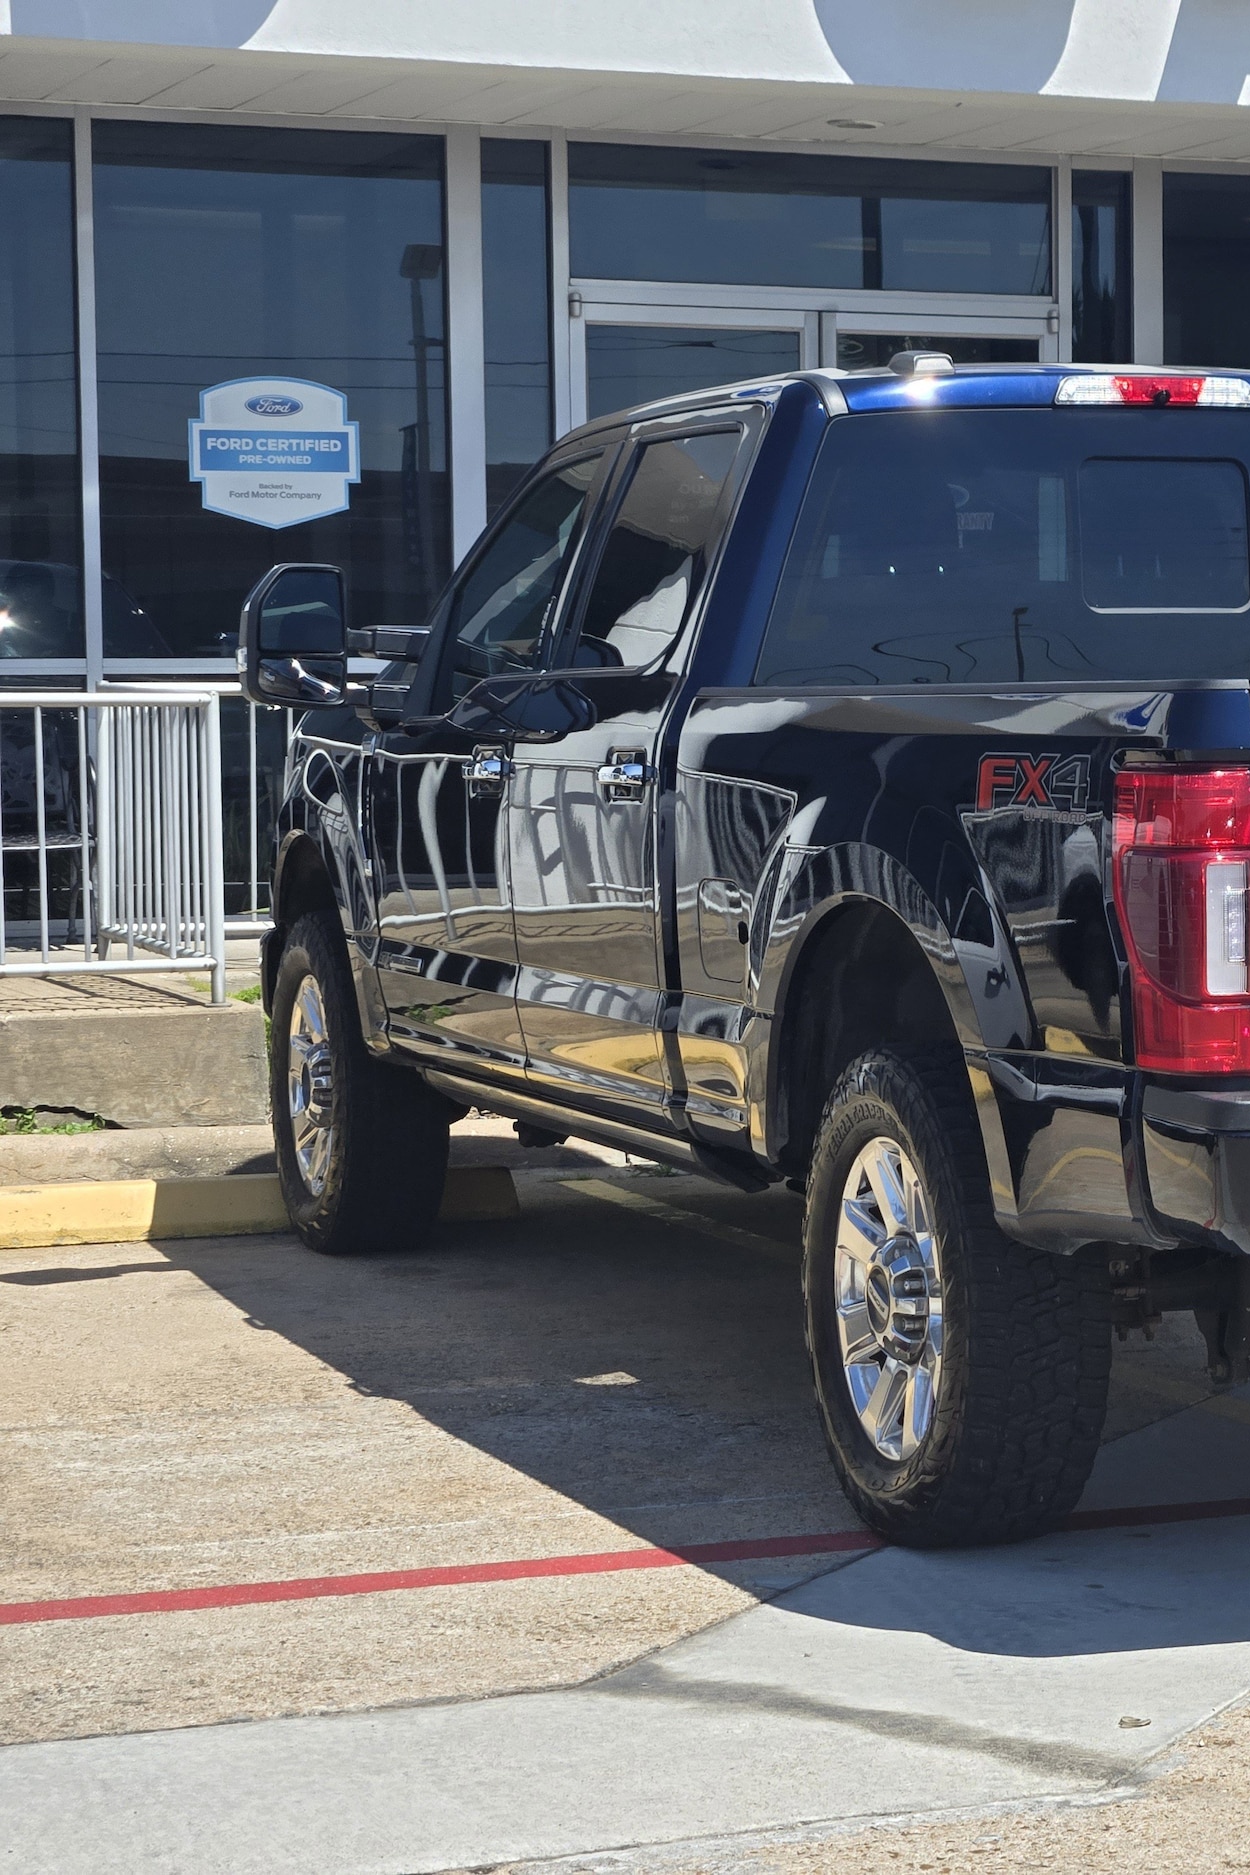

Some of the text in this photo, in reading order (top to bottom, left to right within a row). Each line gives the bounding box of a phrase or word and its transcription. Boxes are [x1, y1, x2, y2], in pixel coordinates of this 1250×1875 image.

[256, 398, 291, 413] Ford
[206, 437, 342, 452] FORD CERTIFIED
[239, 455, 312, 465] PRE-OWNED
[284, 483, 293, 491] by
[229, 491, 322, 500] Ford Motor Company
[975, 752, 1091, 815] FX4
